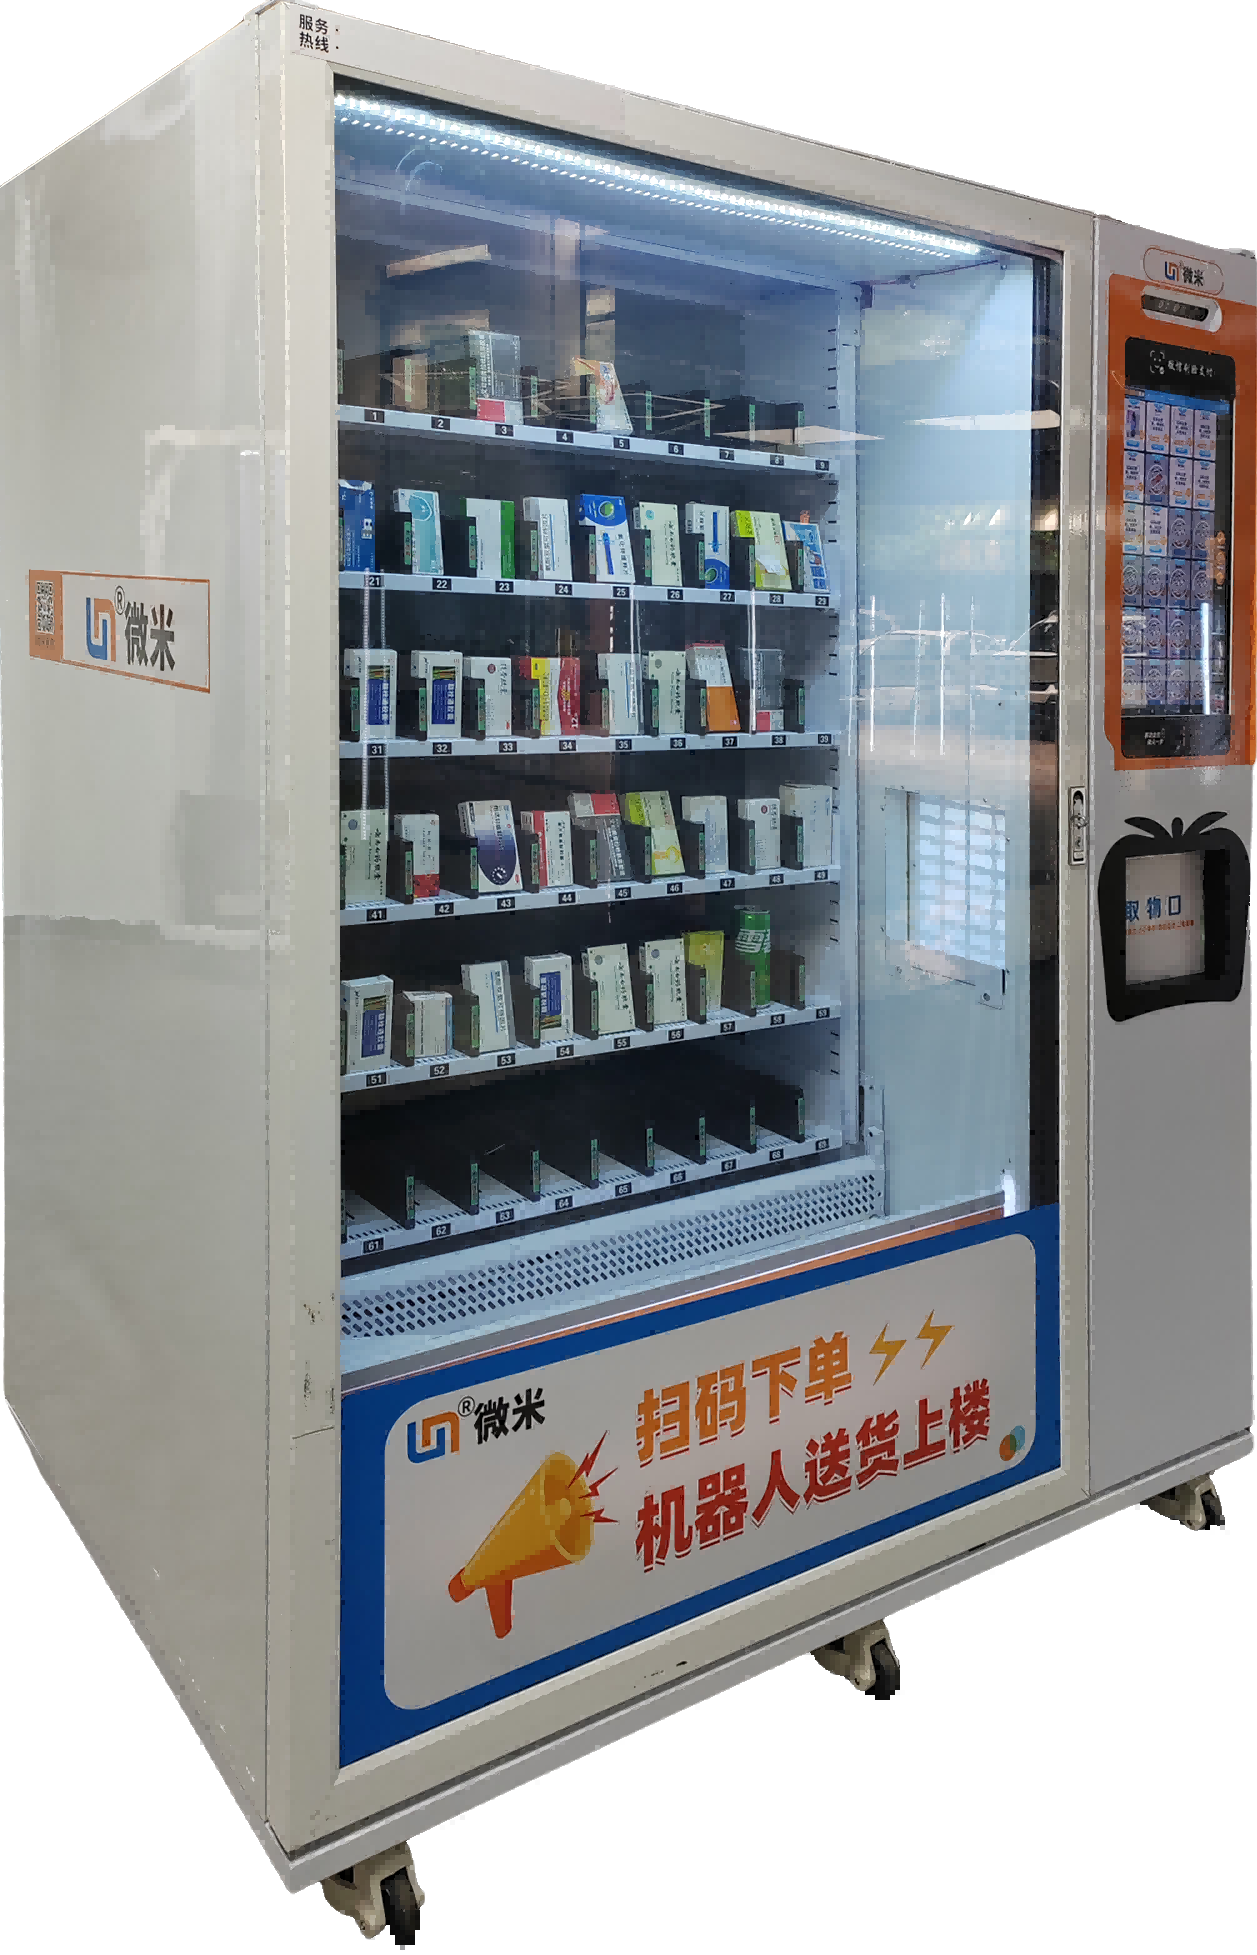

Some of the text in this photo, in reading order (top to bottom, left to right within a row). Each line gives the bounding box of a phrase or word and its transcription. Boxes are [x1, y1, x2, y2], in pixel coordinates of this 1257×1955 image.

[298, 14, 329, 35] 服务
[299, 32, 330, 53] 热线
[1182, 265, 1204, 287] 微米
[369, 576, 381, 586] 21
[436, 580, 447, 588] 22
[499, 583, 510, 591] 23
[558, 585, 568, 593] 24
[617, 588, 626, 596] 25
[670, 590, 680, 599] 26
[124, 600, 176, 671] 微米
[725, 738, 734, 746] 37
[820, 735, 829, 743] 39
[372, 745, 382, 754] 31
[437, 744, 448, 753] 32
[503, 742, 513, 751] 33
[563, 741, 572, 750] 34
[619, 741, 628, 749] 35
[723, 879, 732, 887] 47
[670, 884, 679, 892] 46
[618, 889, 628, 897] 45
[562, 894, 572, 902] 44
[501, 899, 511, 907] 43
[439, 904, 449, 913] 42
[371, 910, 382, 919] 41
[723, 1023, 732, 1031] 57
[671, 1030, 681, 1039] 56
[617, 1038, 627, 1047] 55
[560, 1047, 570, 1056] 54
[501, 1055, 511, 1065] 53
[434, 1066, 445, 1075] 52
[371, 1075, 381, 1084] 51
[619, 1185, 628, 1194] 65
[559, 1198, 569, 1208] 64
[436, 1226, 446, 1235] 62
[368, 1241, 380, 1251] 61
[635, 1331, 852, 1468] 扫码下单
[473, 1387, 546, 1445] 微米
[635, 1378, 991, 1573] 机器人送货上楼
